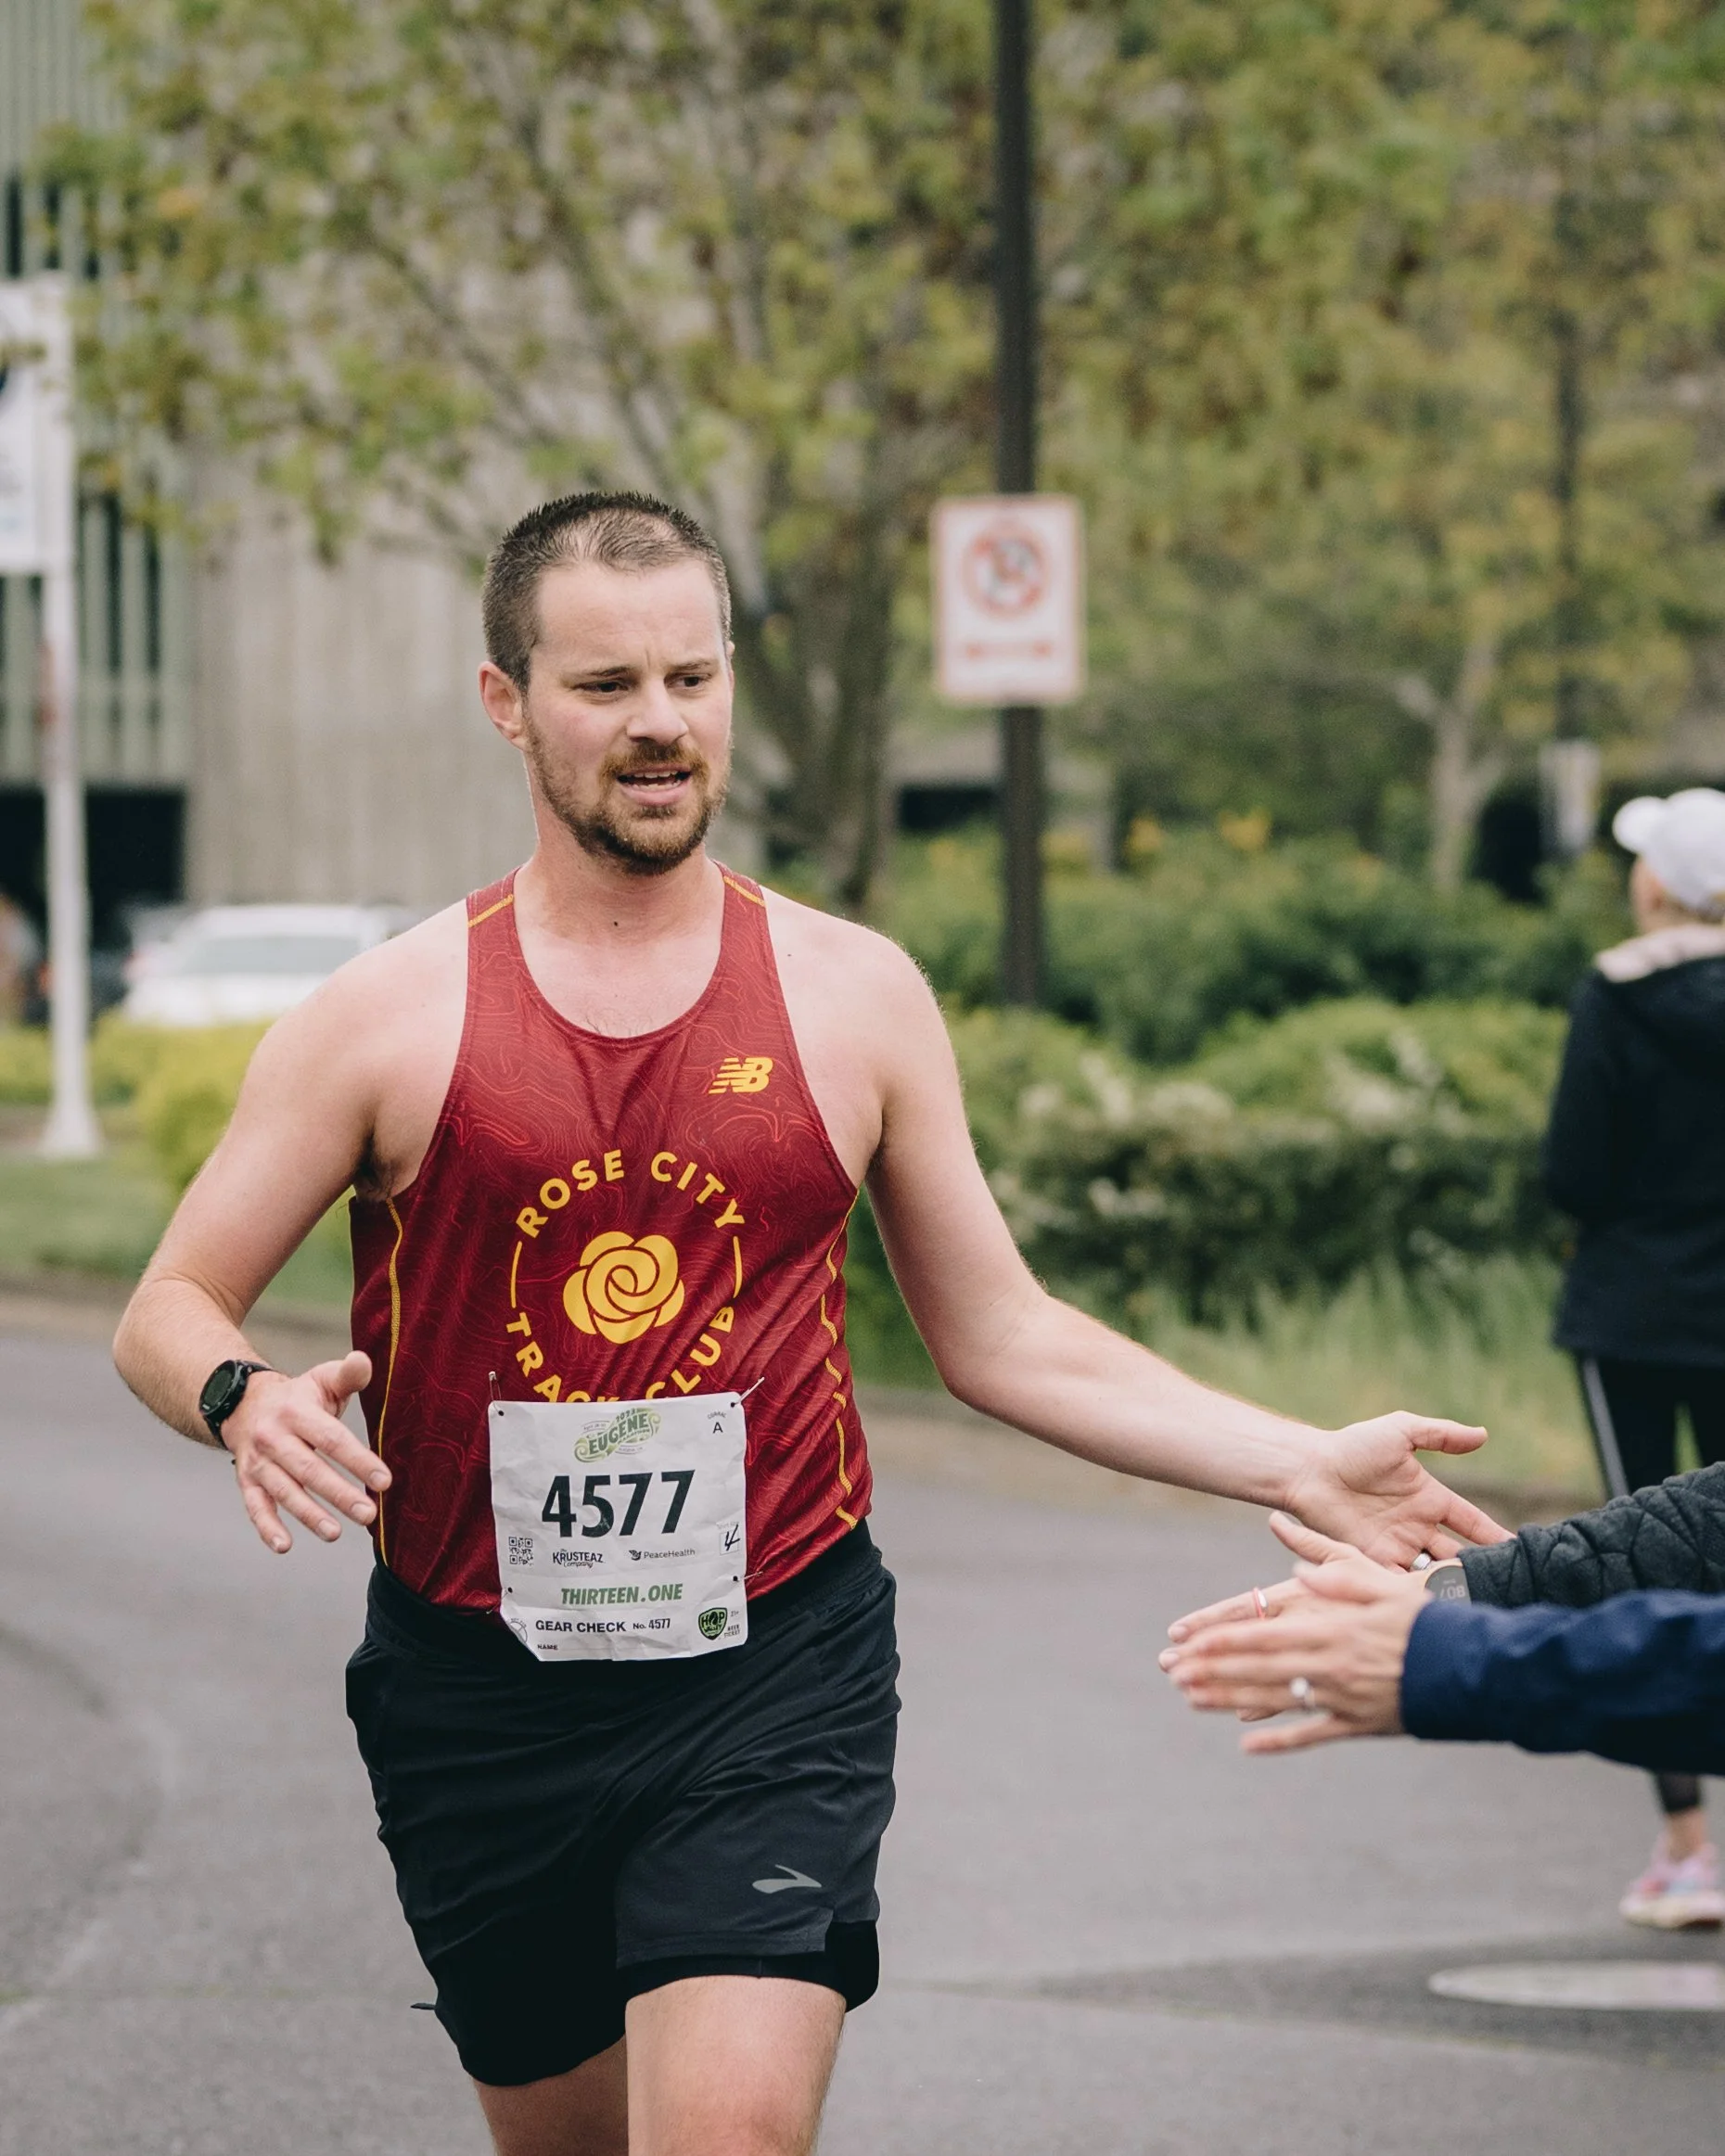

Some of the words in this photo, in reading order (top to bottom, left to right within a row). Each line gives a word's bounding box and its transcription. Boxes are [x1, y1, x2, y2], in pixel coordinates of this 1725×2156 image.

[709, 1057, 773, 1094] NB
[516, 1149, 625, 1239] ROSE
[650, 1151, 745, 1230] CITY
[589, 1413, 649, 1455] EUGENE
[713, 1422, 723, 1434] A
[542, 1470, 695, 1537] 4577
[553, 1550, 604, 1565] KRUSTEAZ
[644, 1548, 696, 1559] PeaceHealth
[535, 1619, 573, 1632] GEAR
[576, 1621, 627, 1632] CHECK
[648, 1618, 671, 1629] 4577
